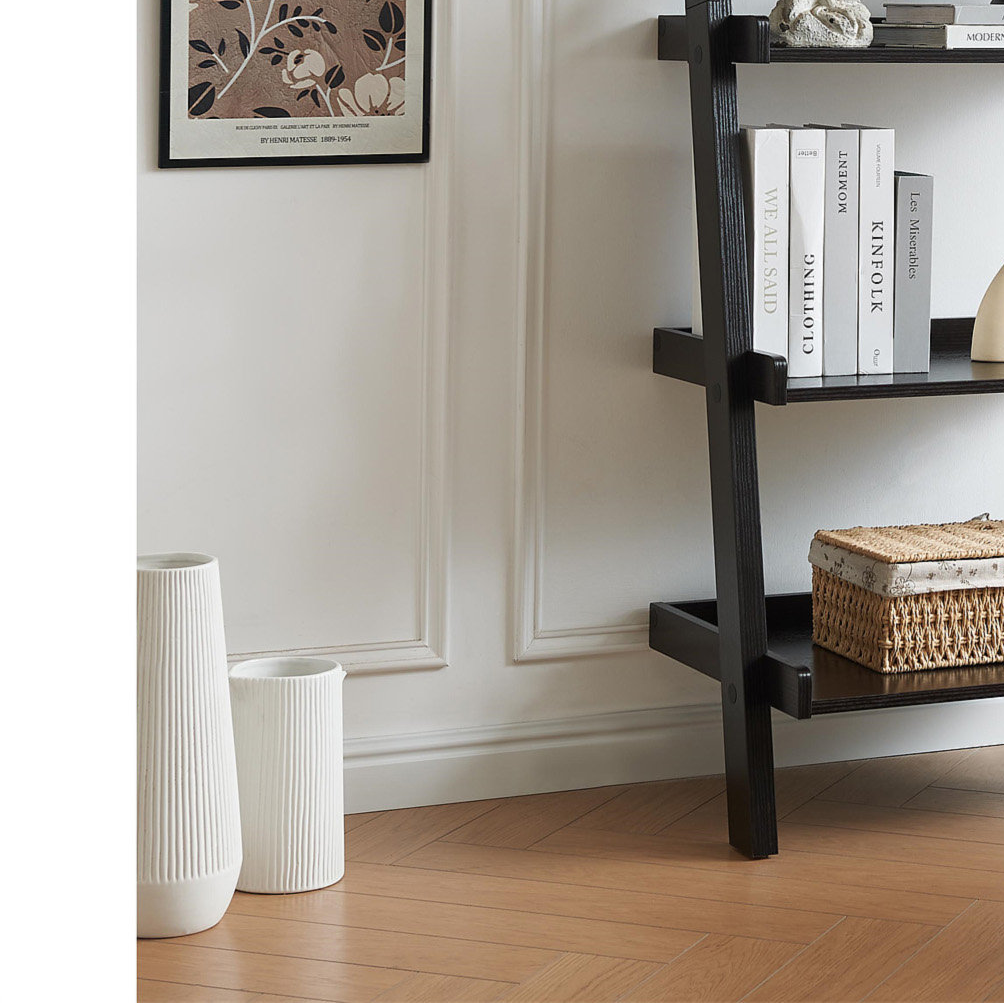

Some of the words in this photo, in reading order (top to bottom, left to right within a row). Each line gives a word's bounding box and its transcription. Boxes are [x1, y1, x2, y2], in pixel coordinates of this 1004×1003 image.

[763, 187, 778, 221] WE
[838, 150, 849, 214] MOMENT
[910, 192, 921, 213] Les
[763, 223, 778, 264] ALL
[871, 220, 884, 313] KINFOLK
[908, 218, 921, 280] Miserables
[762, 266, 778, 314] SAID
[802, 254, 815, 354] CLOTHING
